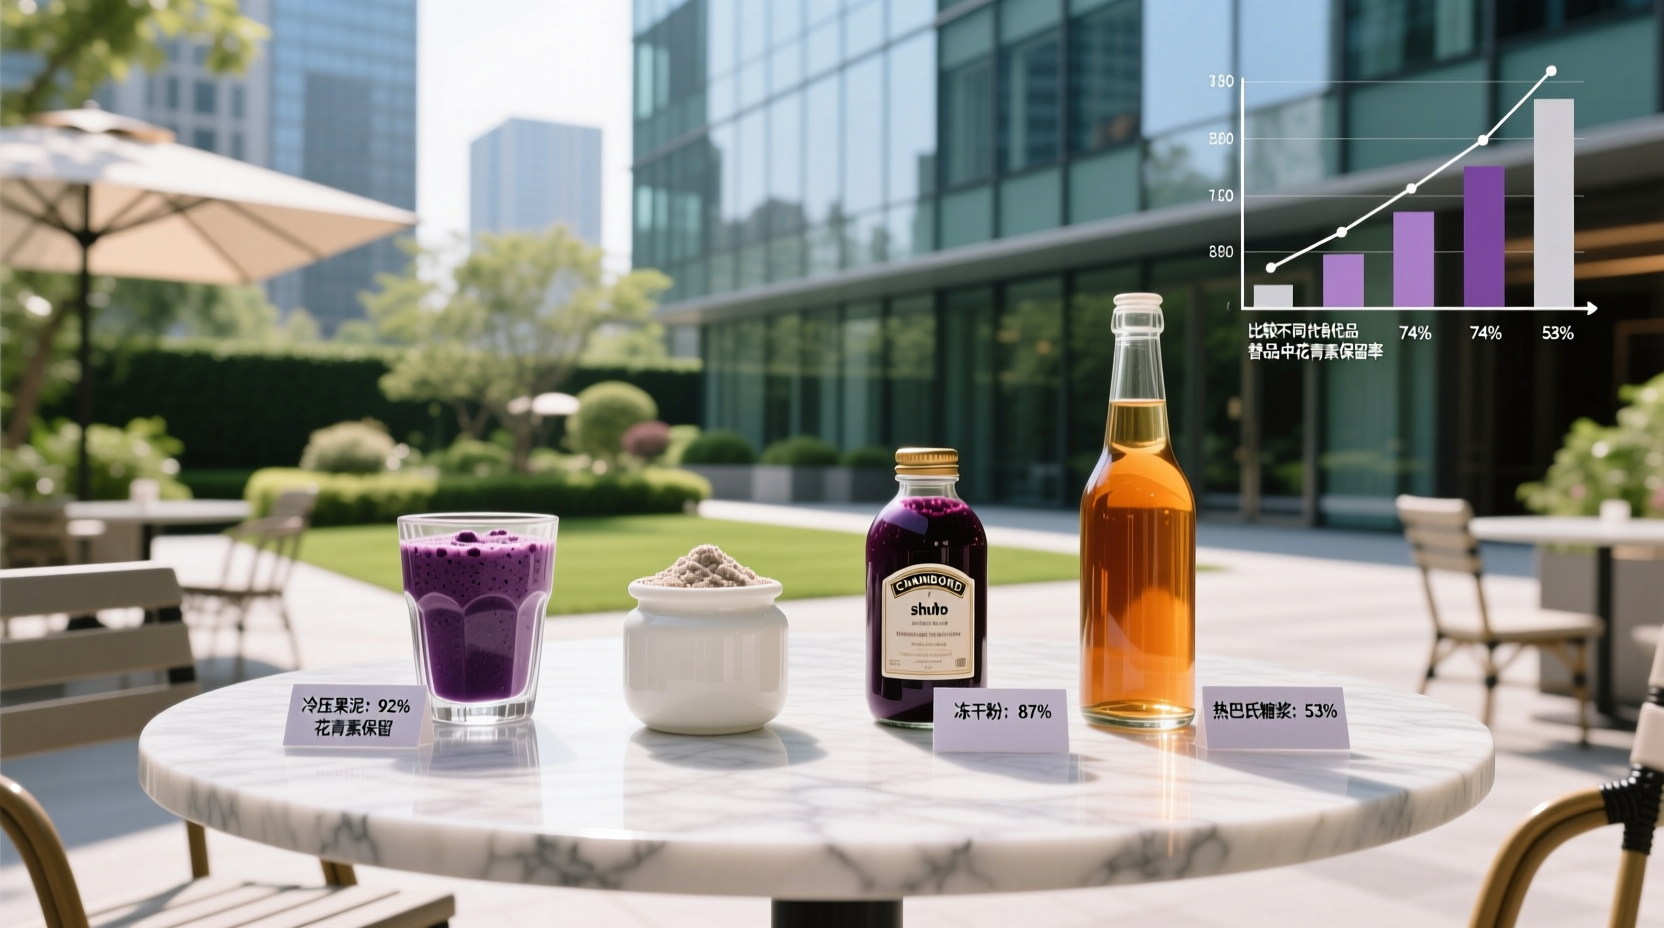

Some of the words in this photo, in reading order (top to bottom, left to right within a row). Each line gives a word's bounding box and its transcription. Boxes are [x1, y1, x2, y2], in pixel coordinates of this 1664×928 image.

[378, 698, 411, 714] 92%
[1018, 703, 1052, 719] 87%
[1304, 702, 1339, 718] 53%
